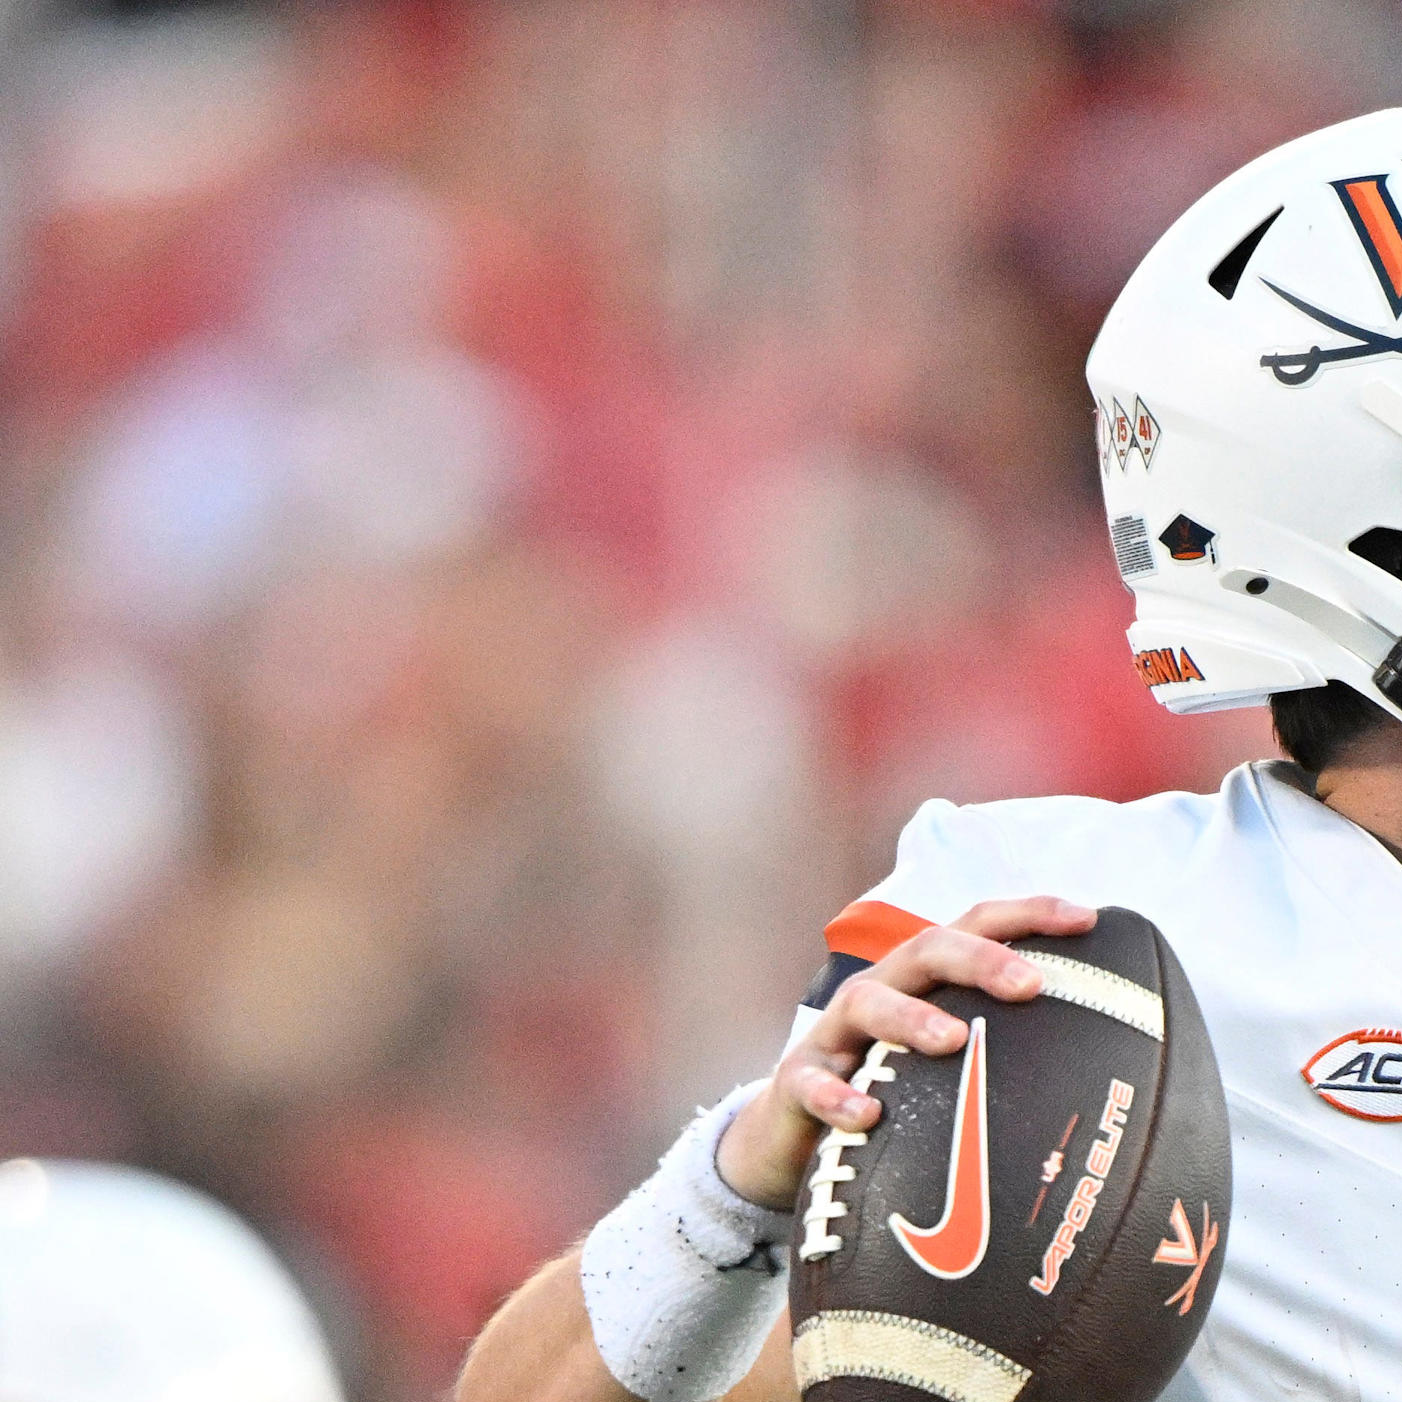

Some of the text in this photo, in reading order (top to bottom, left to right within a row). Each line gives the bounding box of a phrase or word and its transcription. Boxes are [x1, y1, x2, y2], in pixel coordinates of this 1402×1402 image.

[1116, 415, 1128, 443] 15
[1138, 415, 1152, 441] 41
[1028, 1077, 1135, 1296] VAPOR ELITE
